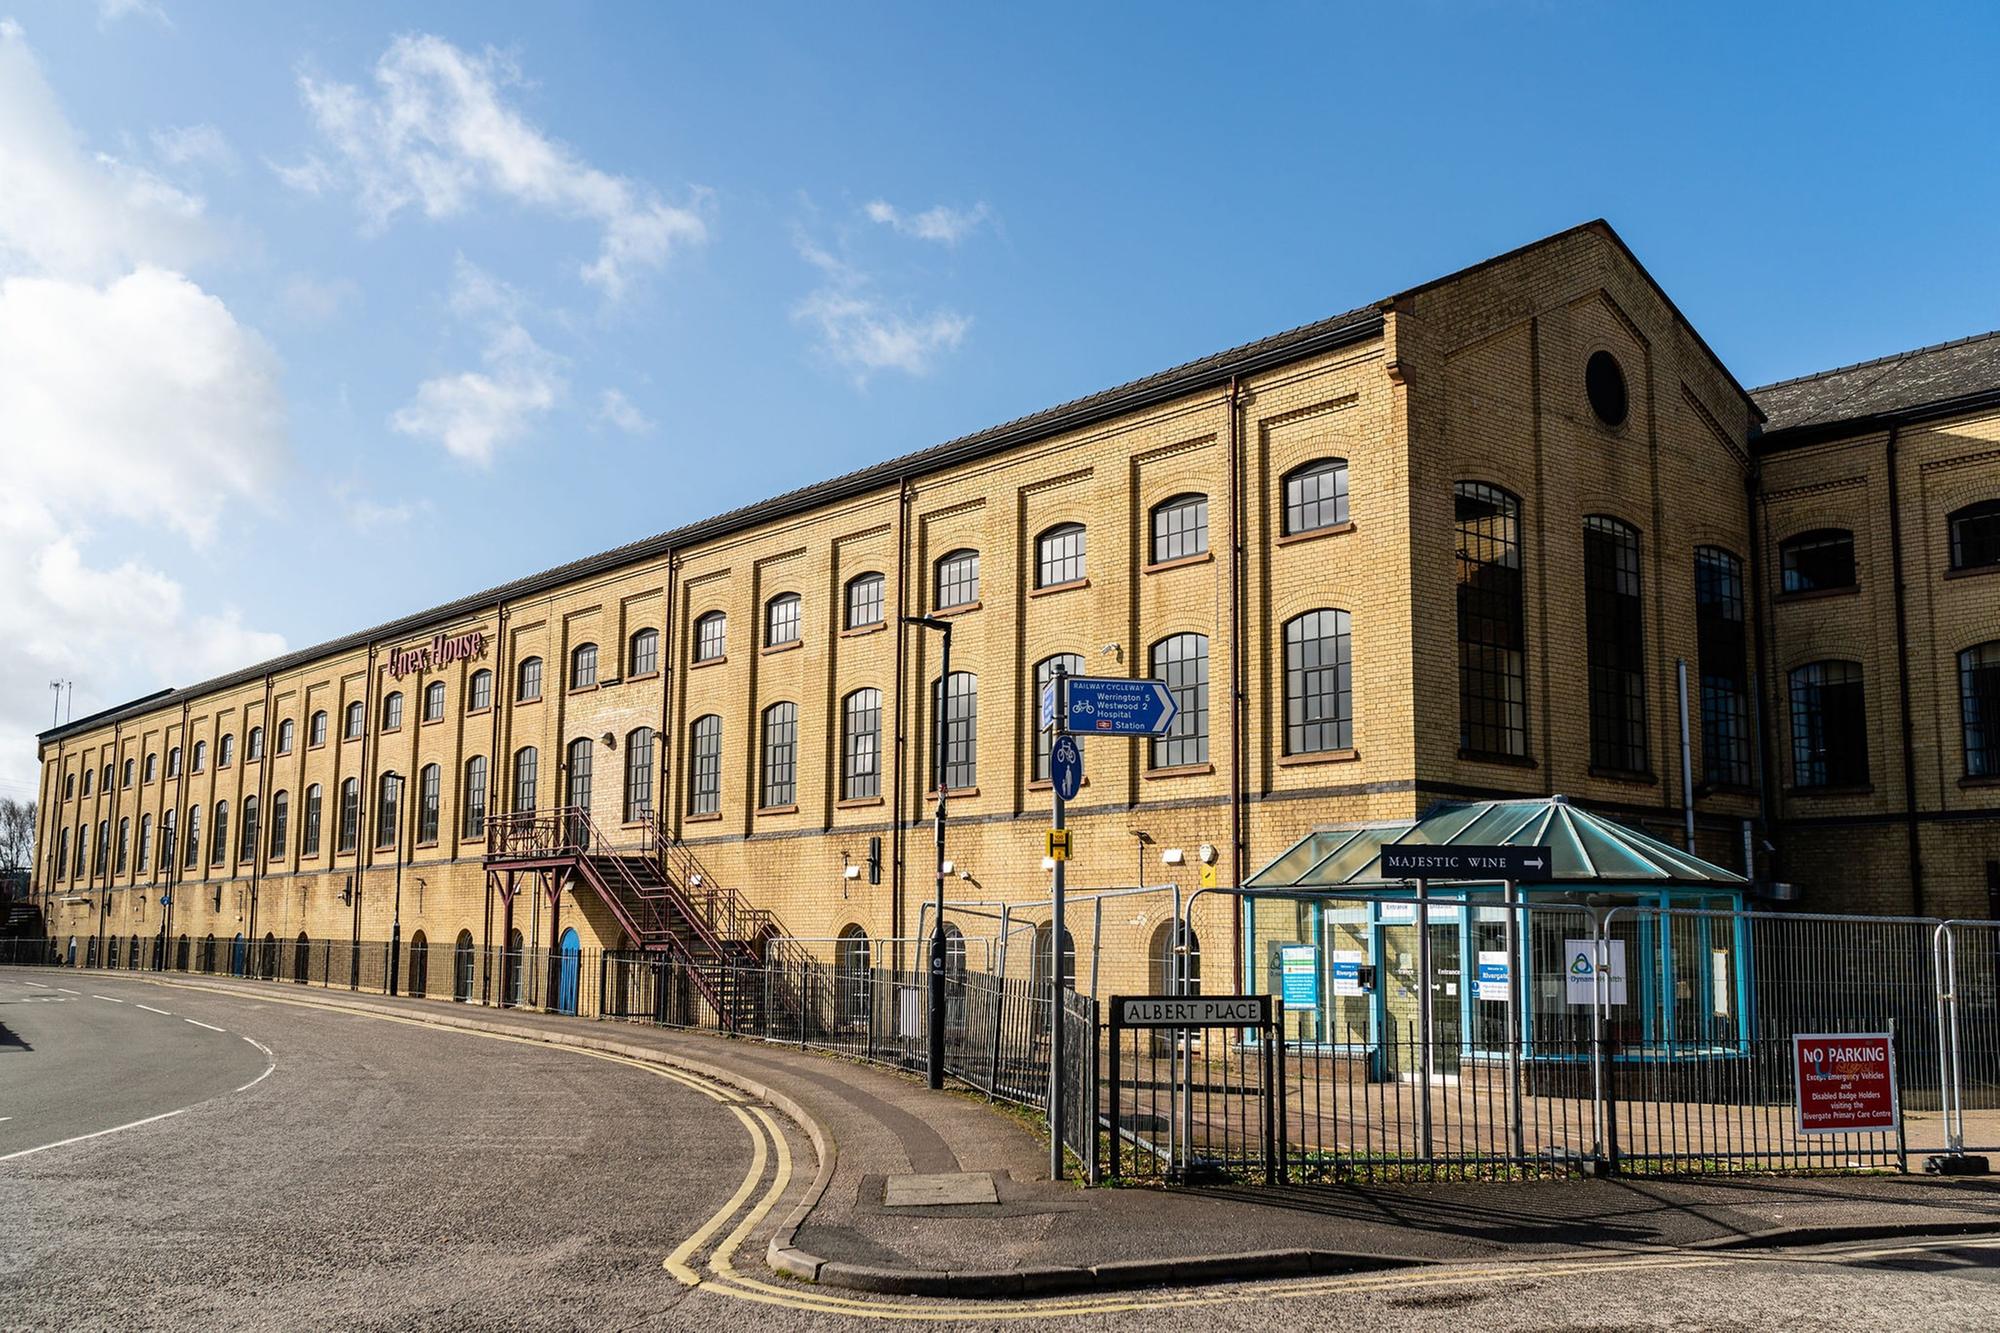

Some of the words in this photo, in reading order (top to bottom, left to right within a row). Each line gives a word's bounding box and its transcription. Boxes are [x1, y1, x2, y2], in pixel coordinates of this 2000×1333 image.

[388, 647, 428, 676] Unex
[429, 632, 483, 666] House
[1106, 684, 1145, 692] CYCLEWAY
[1097, 692, 1141, 702] Werrington
[1097, 701, 1138, 710] Westwood
[1142, 703, 1148, 711] 2
[1097, 710, 1132, 719] Hospital
[1115, 721, 1145, 730] Station
[1050, 833, 1069, 857] H
[1388, 856, 1459, 868] MAJESTIC
[1468, 857, 1507, 868] WINE
[1128, 1004, 1197, 1020] ALBERT
[1205, 1004, 1257, 1019] PLACE
[1803, 1048, 1823, 1063] NO
[1829, 1047, 1885, 1062] PARKING
[1806, 1073, 1827, 1081] Excep
[1861, 1072, 1884, 1080] Vehicles
[1812, 1092, 1837, 1100] Disabled
[1839, 1092, 1857, 1102] Badge
[1858, 1091, 1880, 1099] Holders
[1830, 1102, 1852, 1110] visiting
[1853, 1101, 1863, 1109] the
[1803, 1112, 1831, 1121] Rivergate
[1872, 1110, 1890, 1118] Centre
